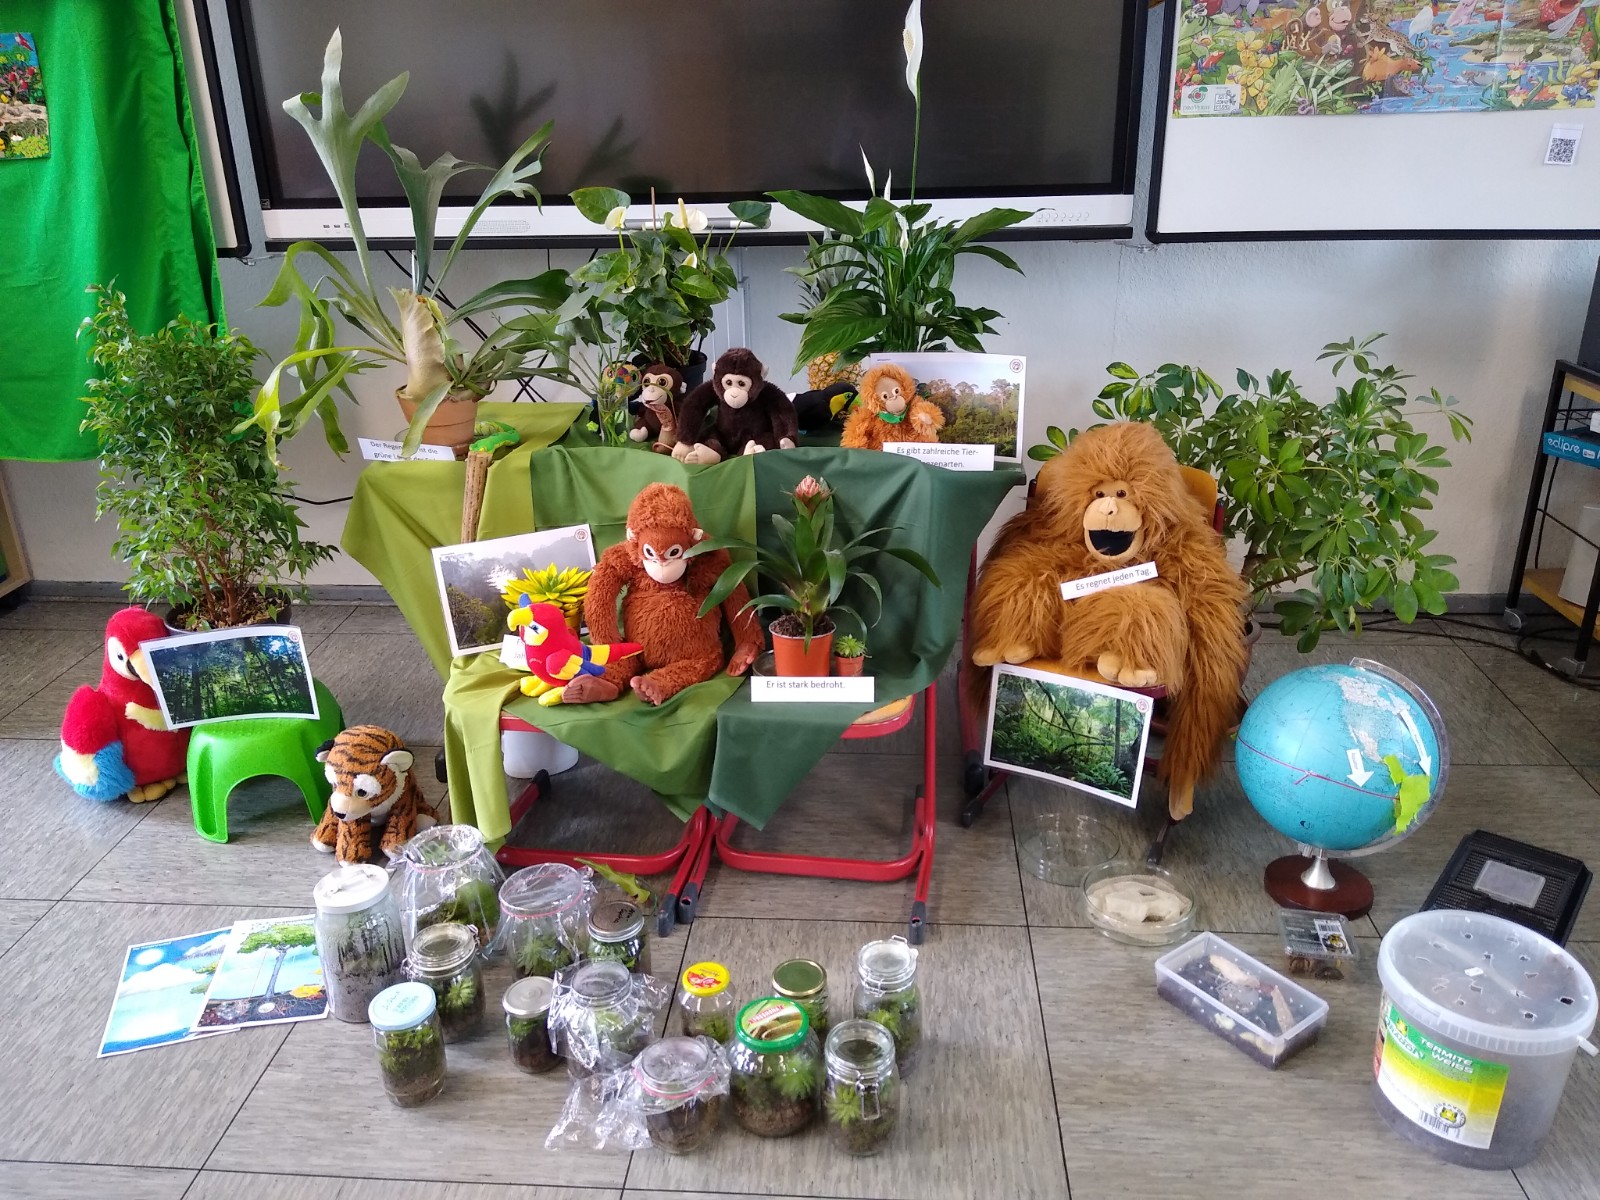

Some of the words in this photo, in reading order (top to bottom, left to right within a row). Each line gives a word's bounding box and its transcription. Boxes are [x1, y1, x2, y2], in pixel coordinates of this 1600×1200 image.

[383, 442, 403, 451] Regen
[896, 446, 905, 454] Es
[906, 446, 921, 456] gibt
[922, 446, 960, 456] zahlreiche
[962, 447, 979, 456] Tier-
[1547, 437, 1581, 453] eclipse
[1075, 582, 1085, 591] Es
[1085, 577, 1111, 589] regnet
[1112, 571, 1135, 584] jeden
[1135, 568, 1152, 578] Tag.
[766, 680, 775, 689] Er
[776, 680, 786, 689] ist
[788, 680, 809, 689] stark
[810, 680, 846, 689] bedroht.
[1419, 1036, 1473, 1066] TERMITE
[1431, 1050, 1474, 1074] WEISS
